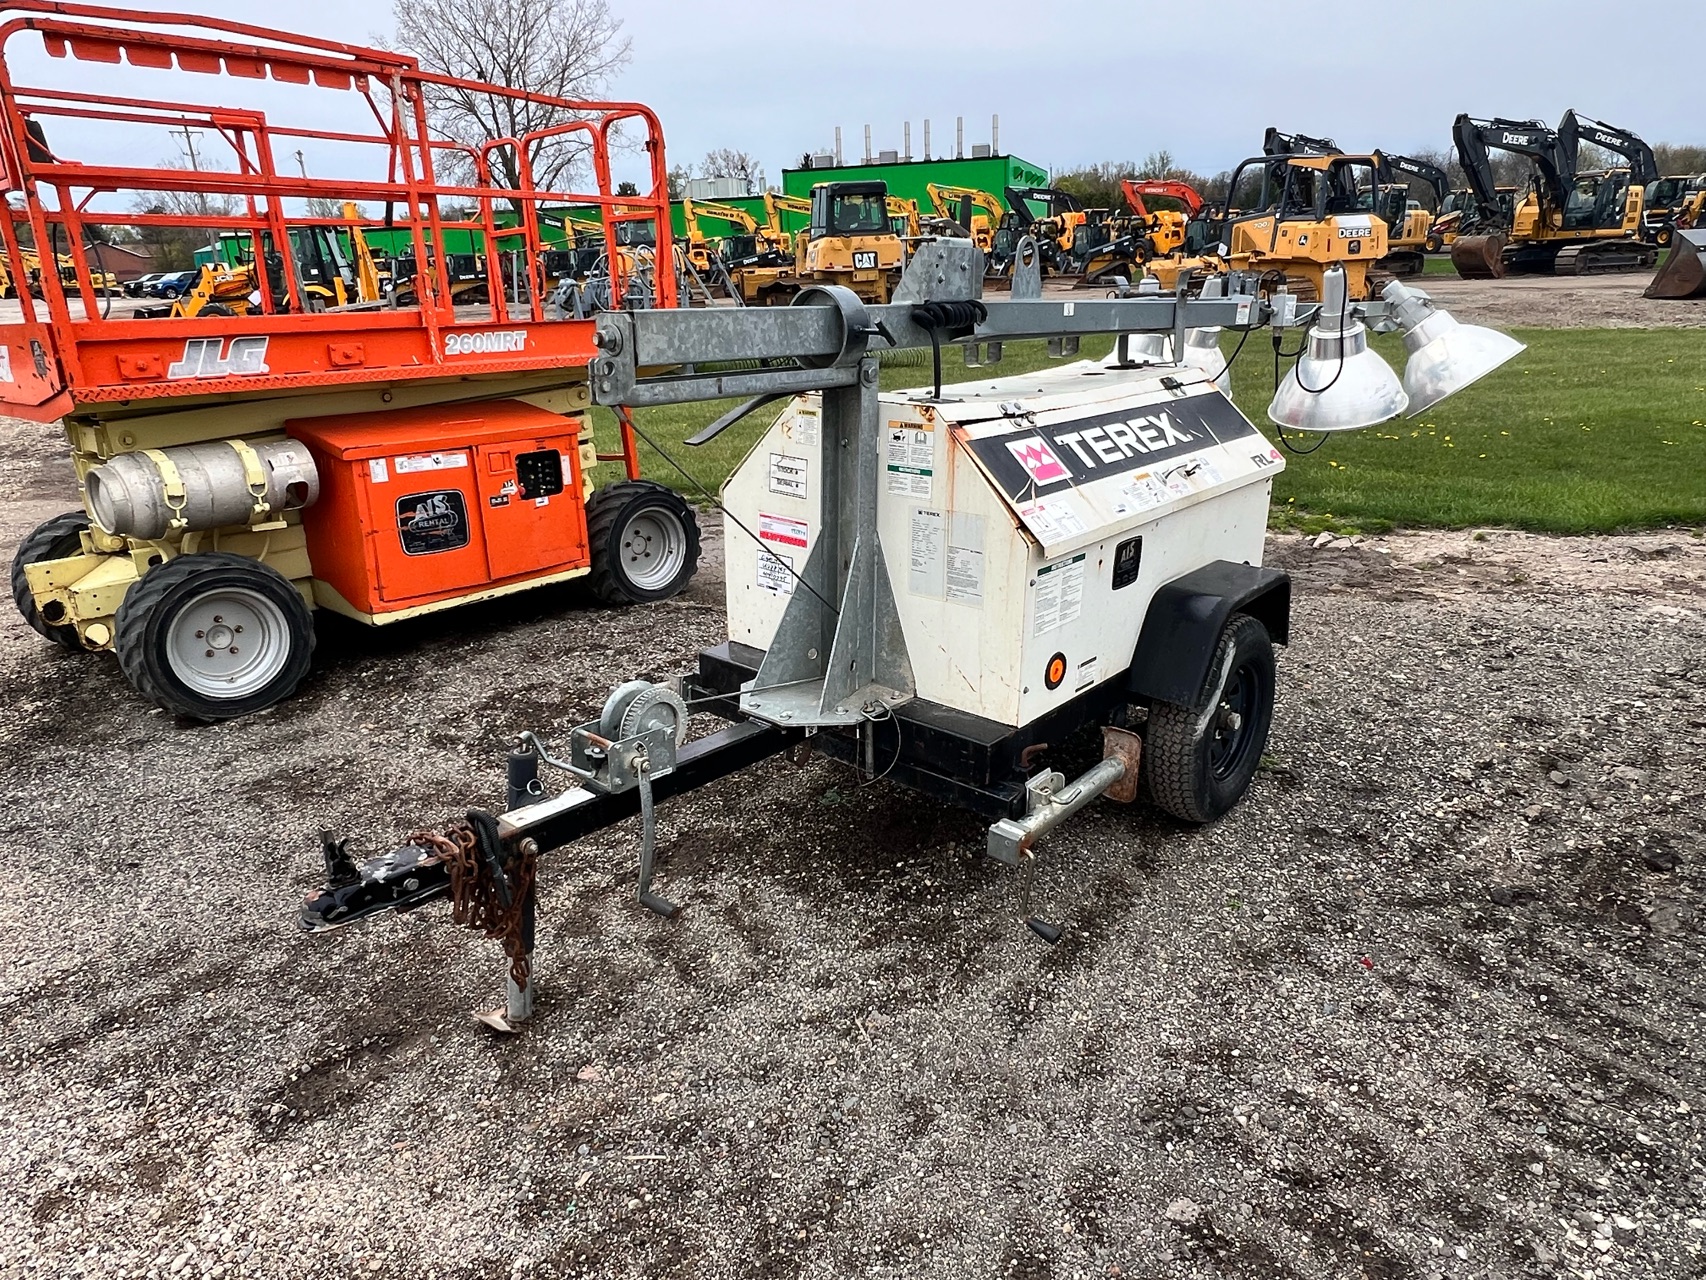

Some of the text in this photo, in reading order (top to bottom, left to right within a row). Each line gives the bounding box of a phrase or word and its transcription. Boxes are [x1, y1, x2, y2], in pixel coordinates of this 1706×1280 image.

[1502, 131, 1529, 146] DEERE
[1594, 132, 1623, 147] DEERE
[1400, 161, 1419, 173] DEERE
[1033, 193, 1051, 201] DEERE
[1338, 227, 1372, 239] DEERE
[854, 252, 876, 269] CAT
[214, 273, 234, 283] JCB
[444, 330, 528, 356] 260MRT
[167, 335, 270, 379] JLG
[1053, 412, 1194, 469] TEREX
[1250, 449, 1283, 468] RL4
[418, 518, 449, 528] RENTAL
